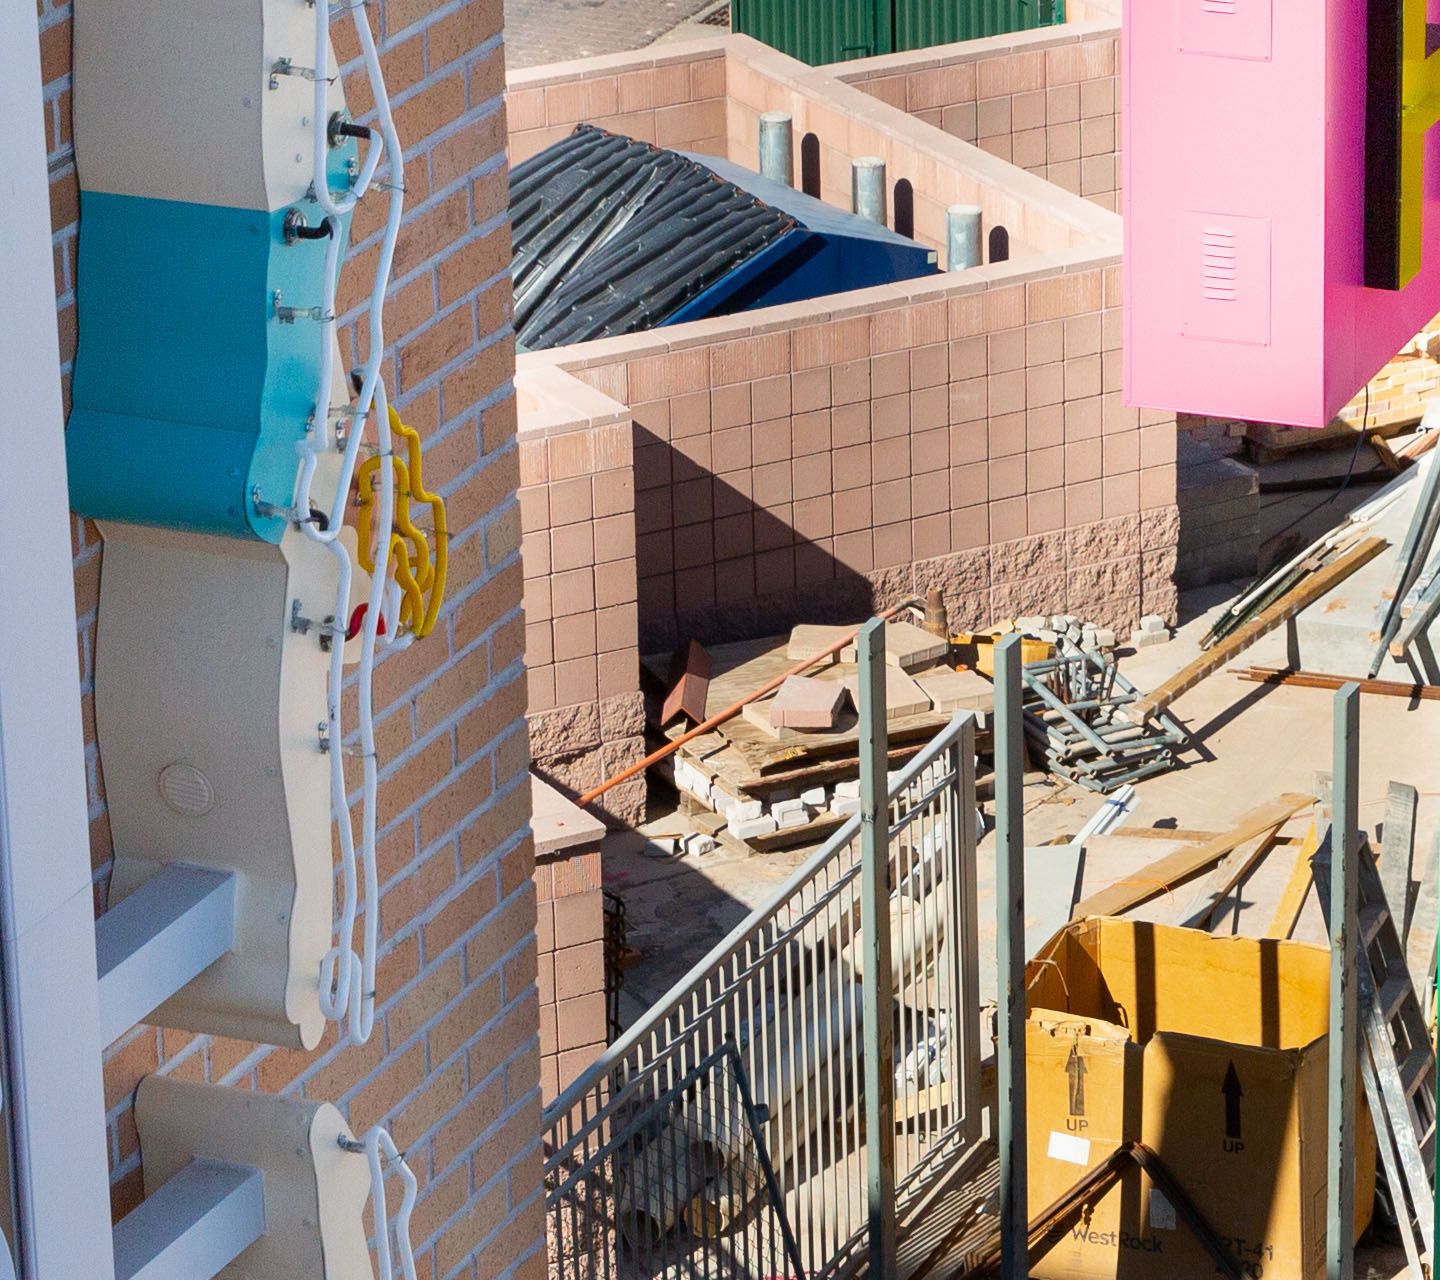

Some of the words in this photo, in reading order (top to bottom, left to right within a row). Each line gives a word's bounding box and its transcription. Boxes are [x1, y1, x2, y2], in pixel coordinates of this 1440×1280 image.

[1066, 1119, 1089, 1132] UP
[1223, 1139, 1245, 1154] UP
[1071, 1227, 1164, 1254] WestRock
